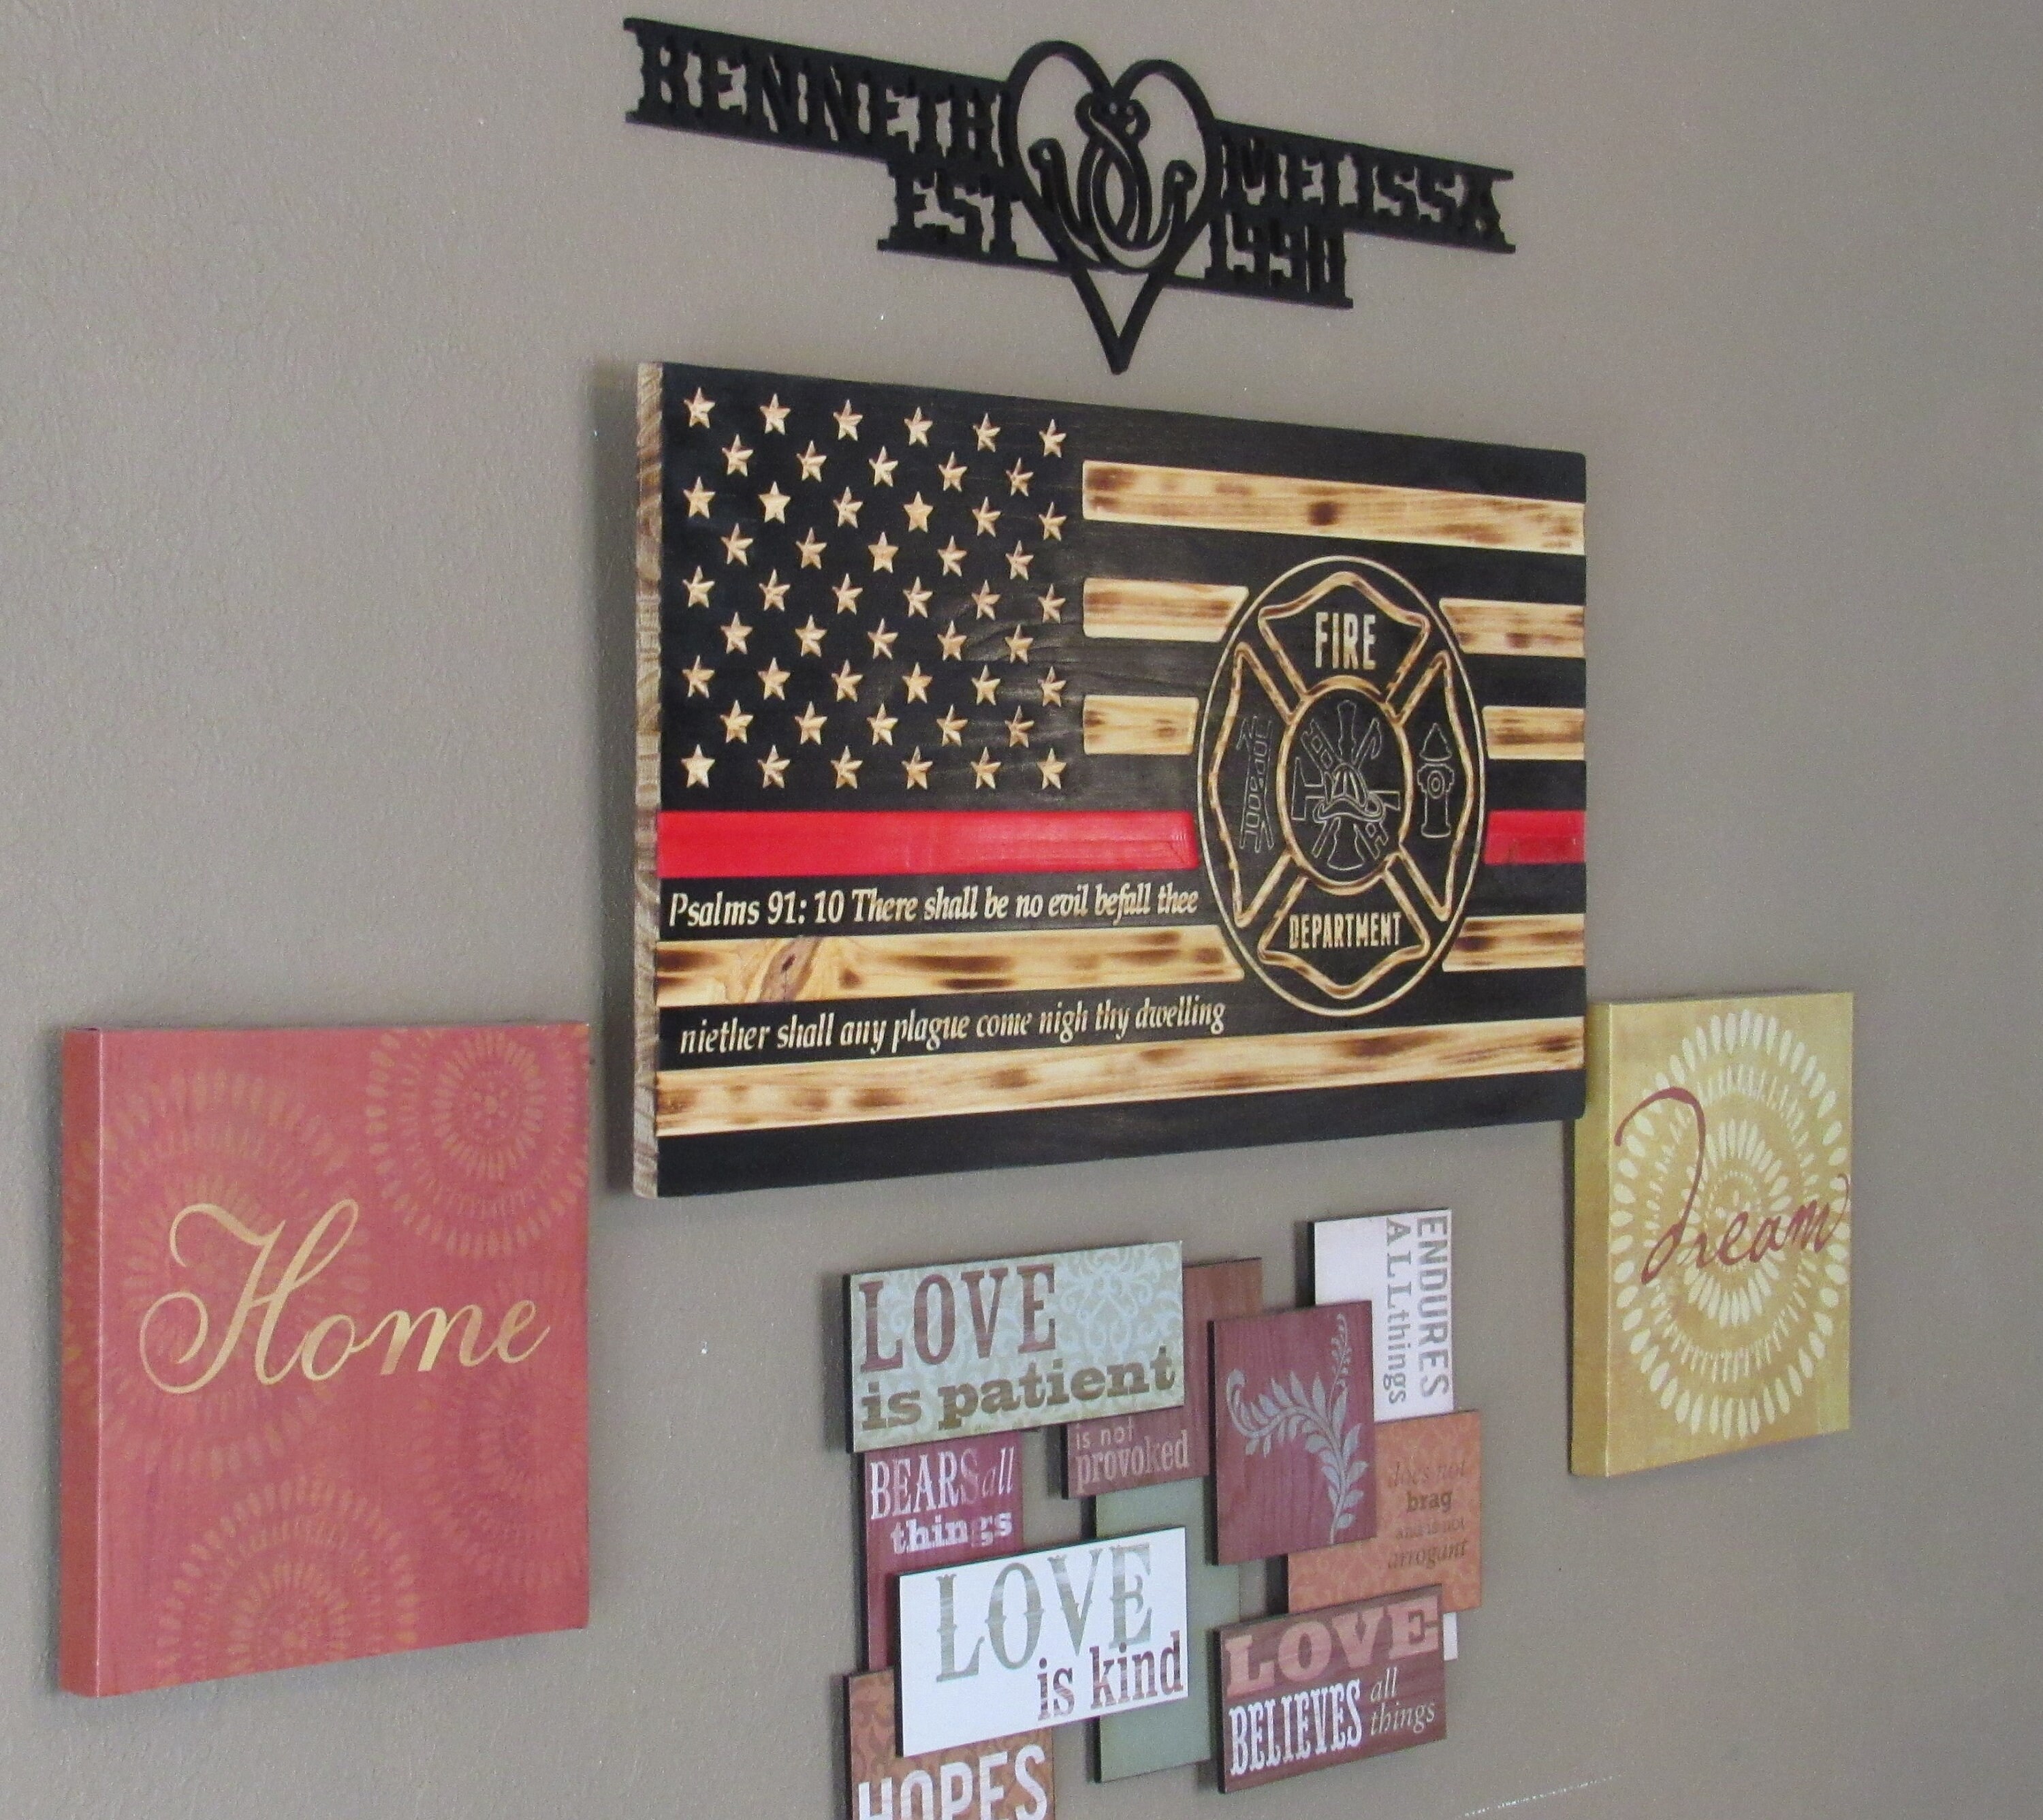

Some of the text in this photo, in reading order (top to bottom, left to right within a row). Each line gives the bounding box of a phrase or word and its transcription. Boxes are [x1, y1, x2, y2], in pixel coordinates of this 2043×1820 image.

[1214, 120, 1517, 255] MELISSA
[876, 163, 1355, 309] EST 1990
[1314, 612, 1378, 671] FIRE
[668, 881, 1199, 928] Psalms 91: 10 There shall be no evil befall thee
[1288, 911, 1402, 950] DEPARTMENT
[679, 994, 1226, 1056] niether shall any plague come nigh thy dwelling
[139, 1198, 550, 1394] Home
[859, 1263, 1057, 1372] LOVE
[1416, 1215, 1450, 1397] ENDURES
[860, 1345, 1176, 1432] is patient
[1075, 1415, 1134, 1450] is not
[1075, 1428, 1190, 1494] provoked
[870, 1446, 1015, 1520] BEARS all
[1406, 1490, 1453, 1513] brag
[890, 1512, 1013, 1554] things
[934, 1541, 1153, 1682] LOVE
[1226, 1596, 1440, 1697] LOVE
[1036, 1629, 1184, 1722] is kind
[1369, 1665, 1400, 1703] all
[1229, 1678, 1363, 1776] BELIEVES
[1369, 1701, 1436, 1738] things
